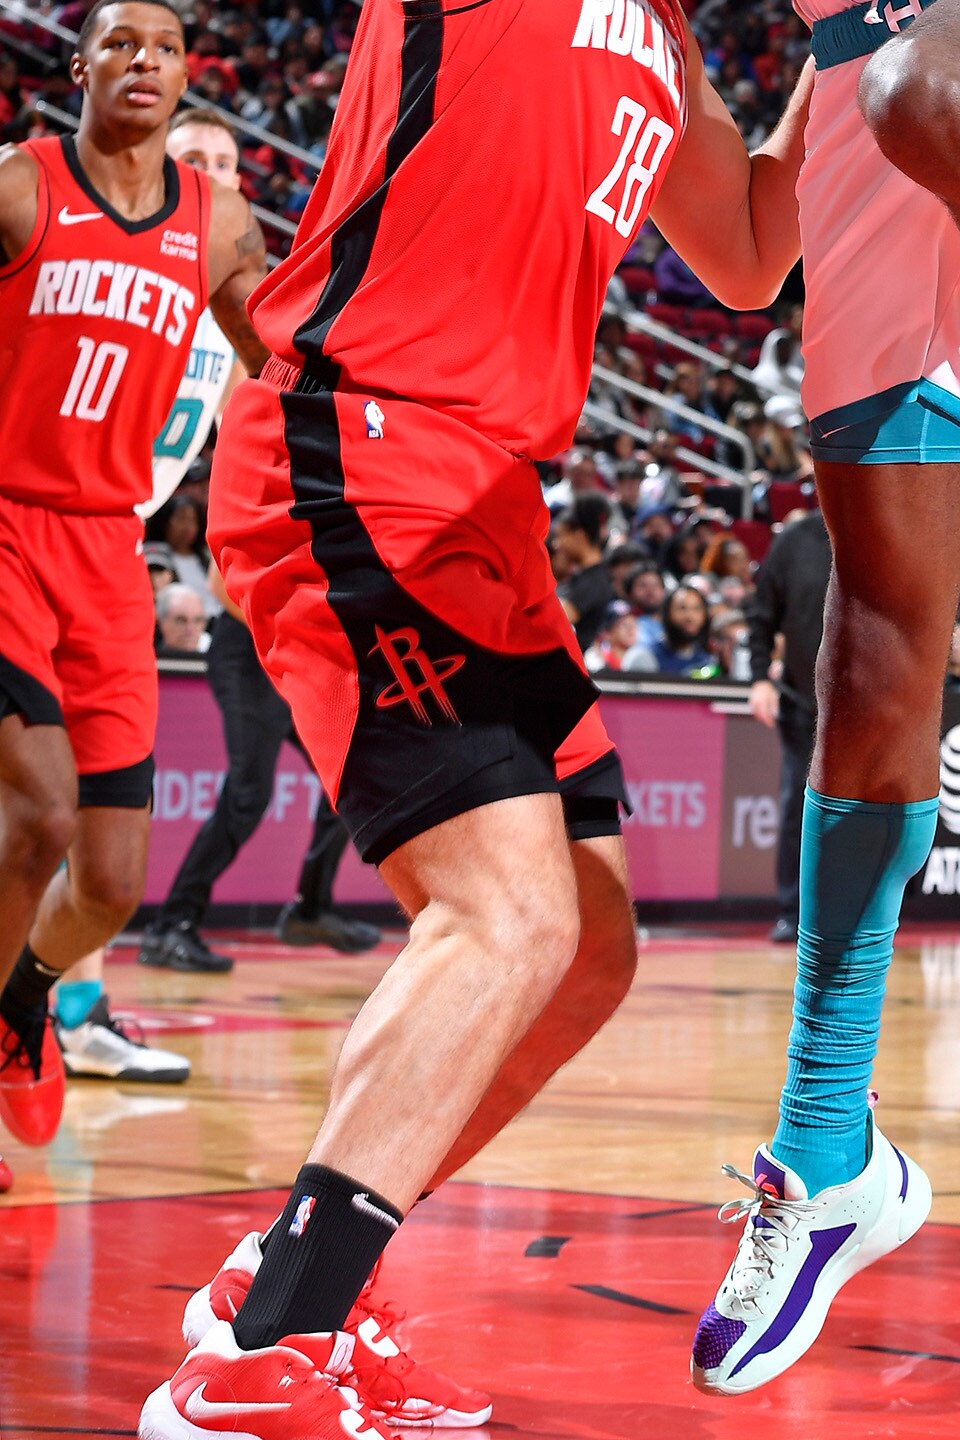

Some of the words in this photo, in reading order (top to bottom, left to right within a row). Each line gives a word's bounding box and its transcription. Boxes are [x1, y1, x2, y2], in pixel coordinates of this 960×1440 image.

[584, 95, 675, 238] 28
[160, 240, 197, 261] karma
[163, 230, 198, 248] credit
[28, 259, 195, 347] ROCKETS
[59, 335, 129, 423] 10
[731, 793, 780, 850] re
